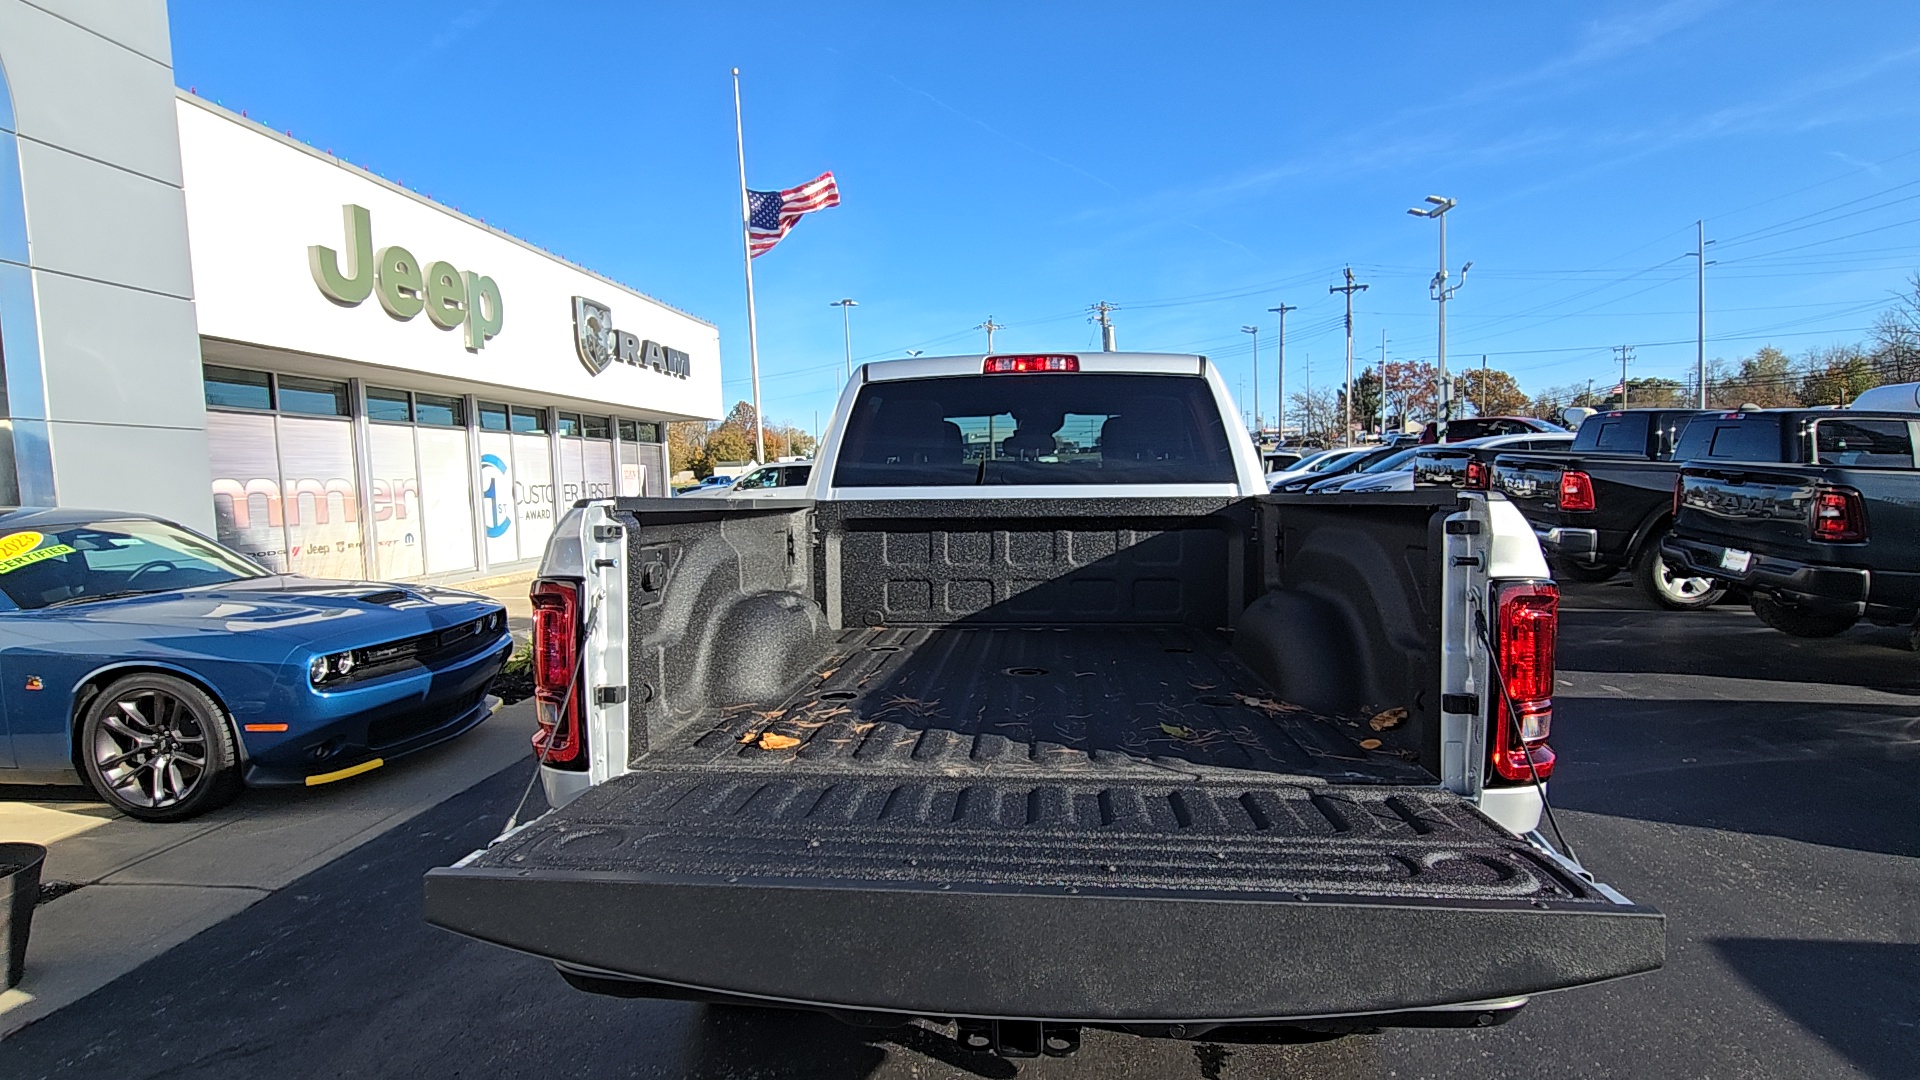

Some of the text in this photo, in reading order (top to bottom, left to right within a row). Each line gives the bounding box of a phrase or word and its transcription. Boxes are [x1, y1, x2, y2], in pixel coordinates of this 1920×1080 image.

[308, 203, 503, 354] Jeep
[614, 329, 691, 379] RAM
[515, 480, 579, 505] CUSTOER
[1503, 477, 1537, 490] RAM
[1704, 493, 1764, 511] RAM
[525, 509, 551, 521] AWARD
[0, 534, 35, 557] 2023
[306, 543, 330, 556] Jeep
[0, 546, 69, 571] CERTIFIED
